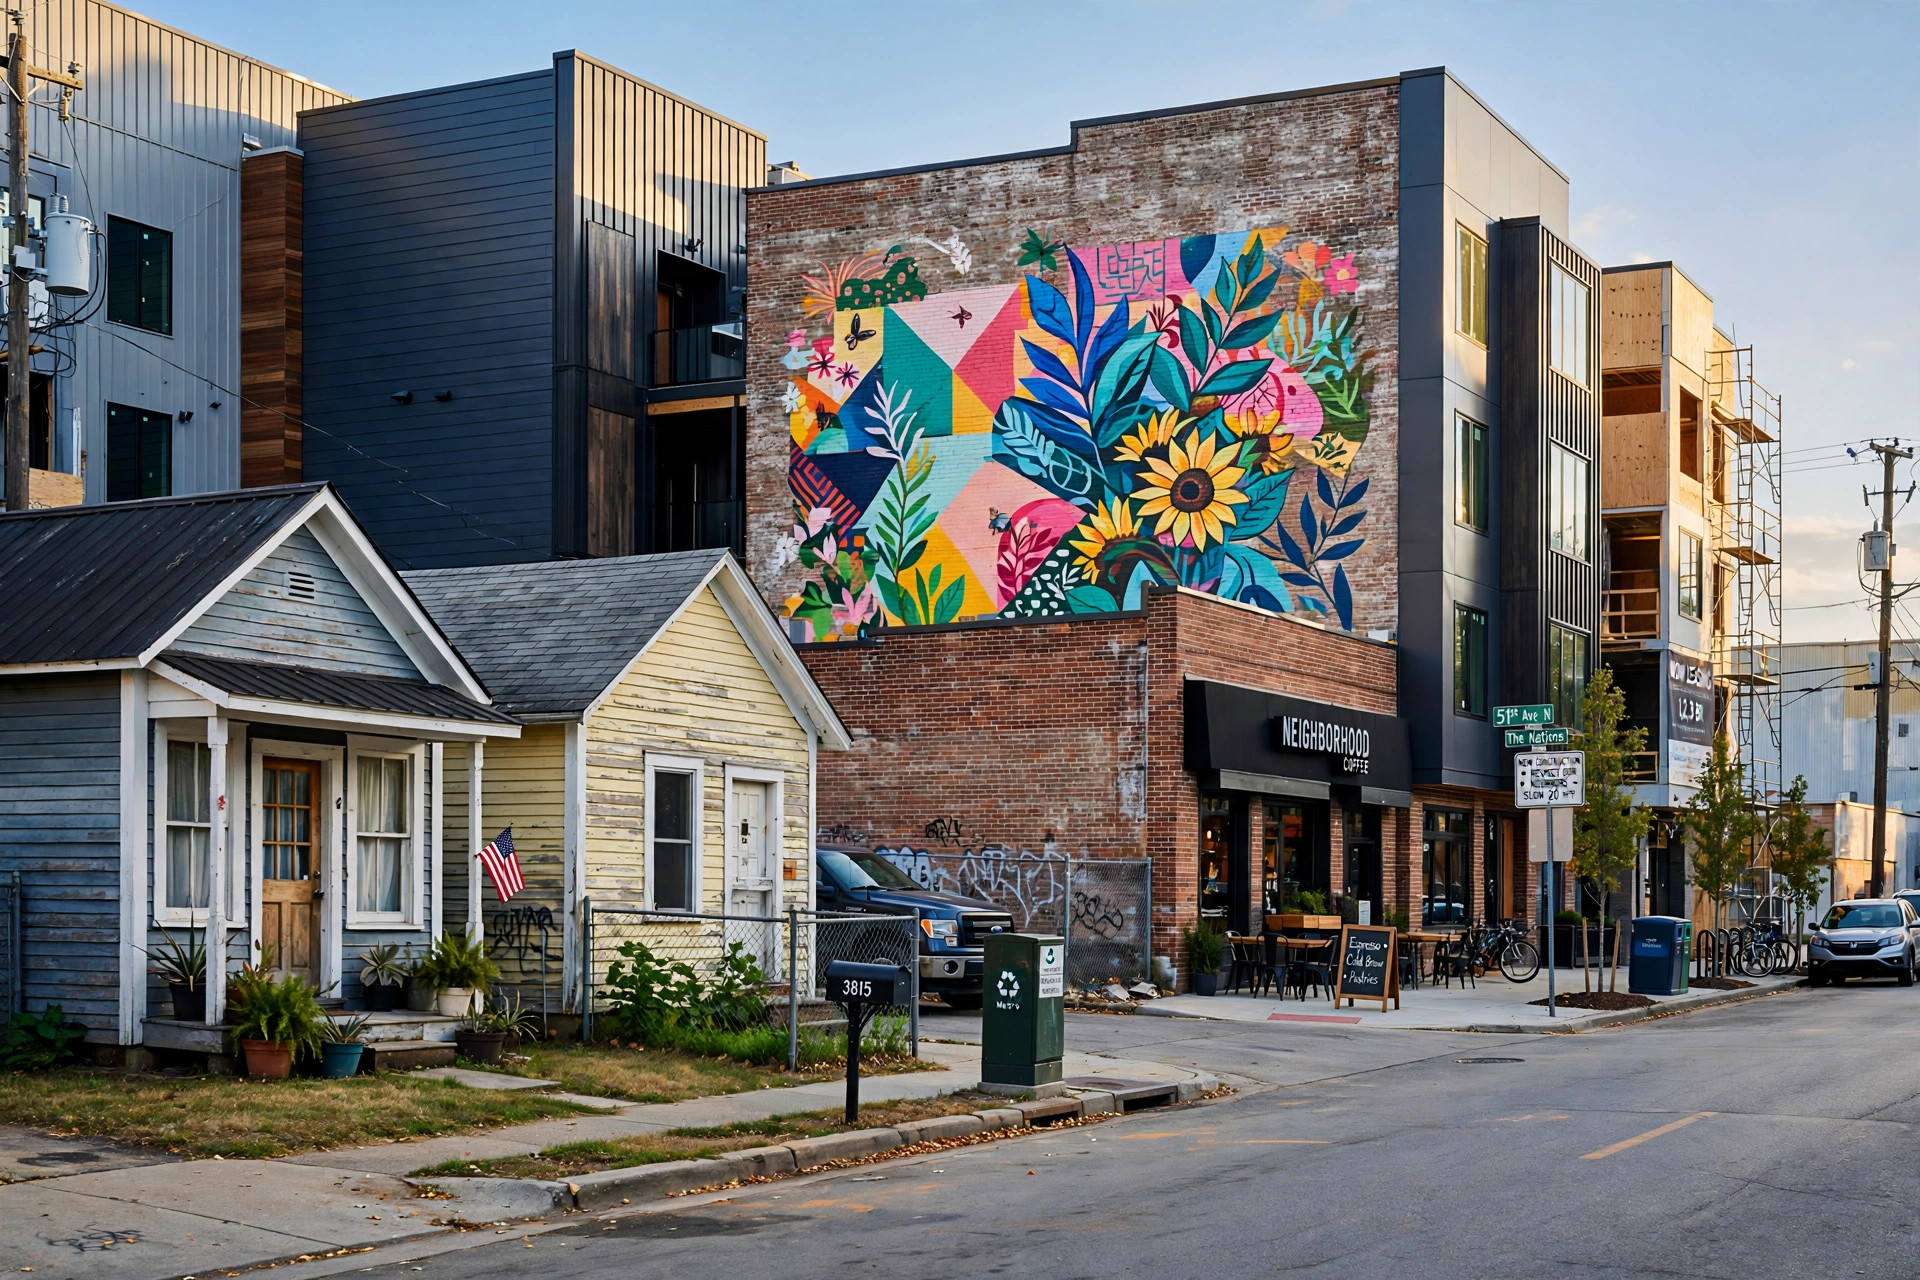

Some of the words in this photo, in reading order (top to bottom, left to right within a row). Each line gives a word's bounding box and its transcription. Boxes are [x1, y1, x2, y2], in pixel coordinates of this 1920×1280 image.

[1522, 709, 1539, 722] Ave
[1543, 707, 1551, 721] N
[1283, 715, 1369, 758] NEIGHBORHOOD
[1506, 732, 1525, 745] The
[1343, 756, 1369, 775] COFFEE
[1523, 790, 1544, 801] SLOW
[1548, 789, 1559, 801] 20
[1348, 970, 1378, 984] Pastries
[842, 979, 872, 997] 3815
